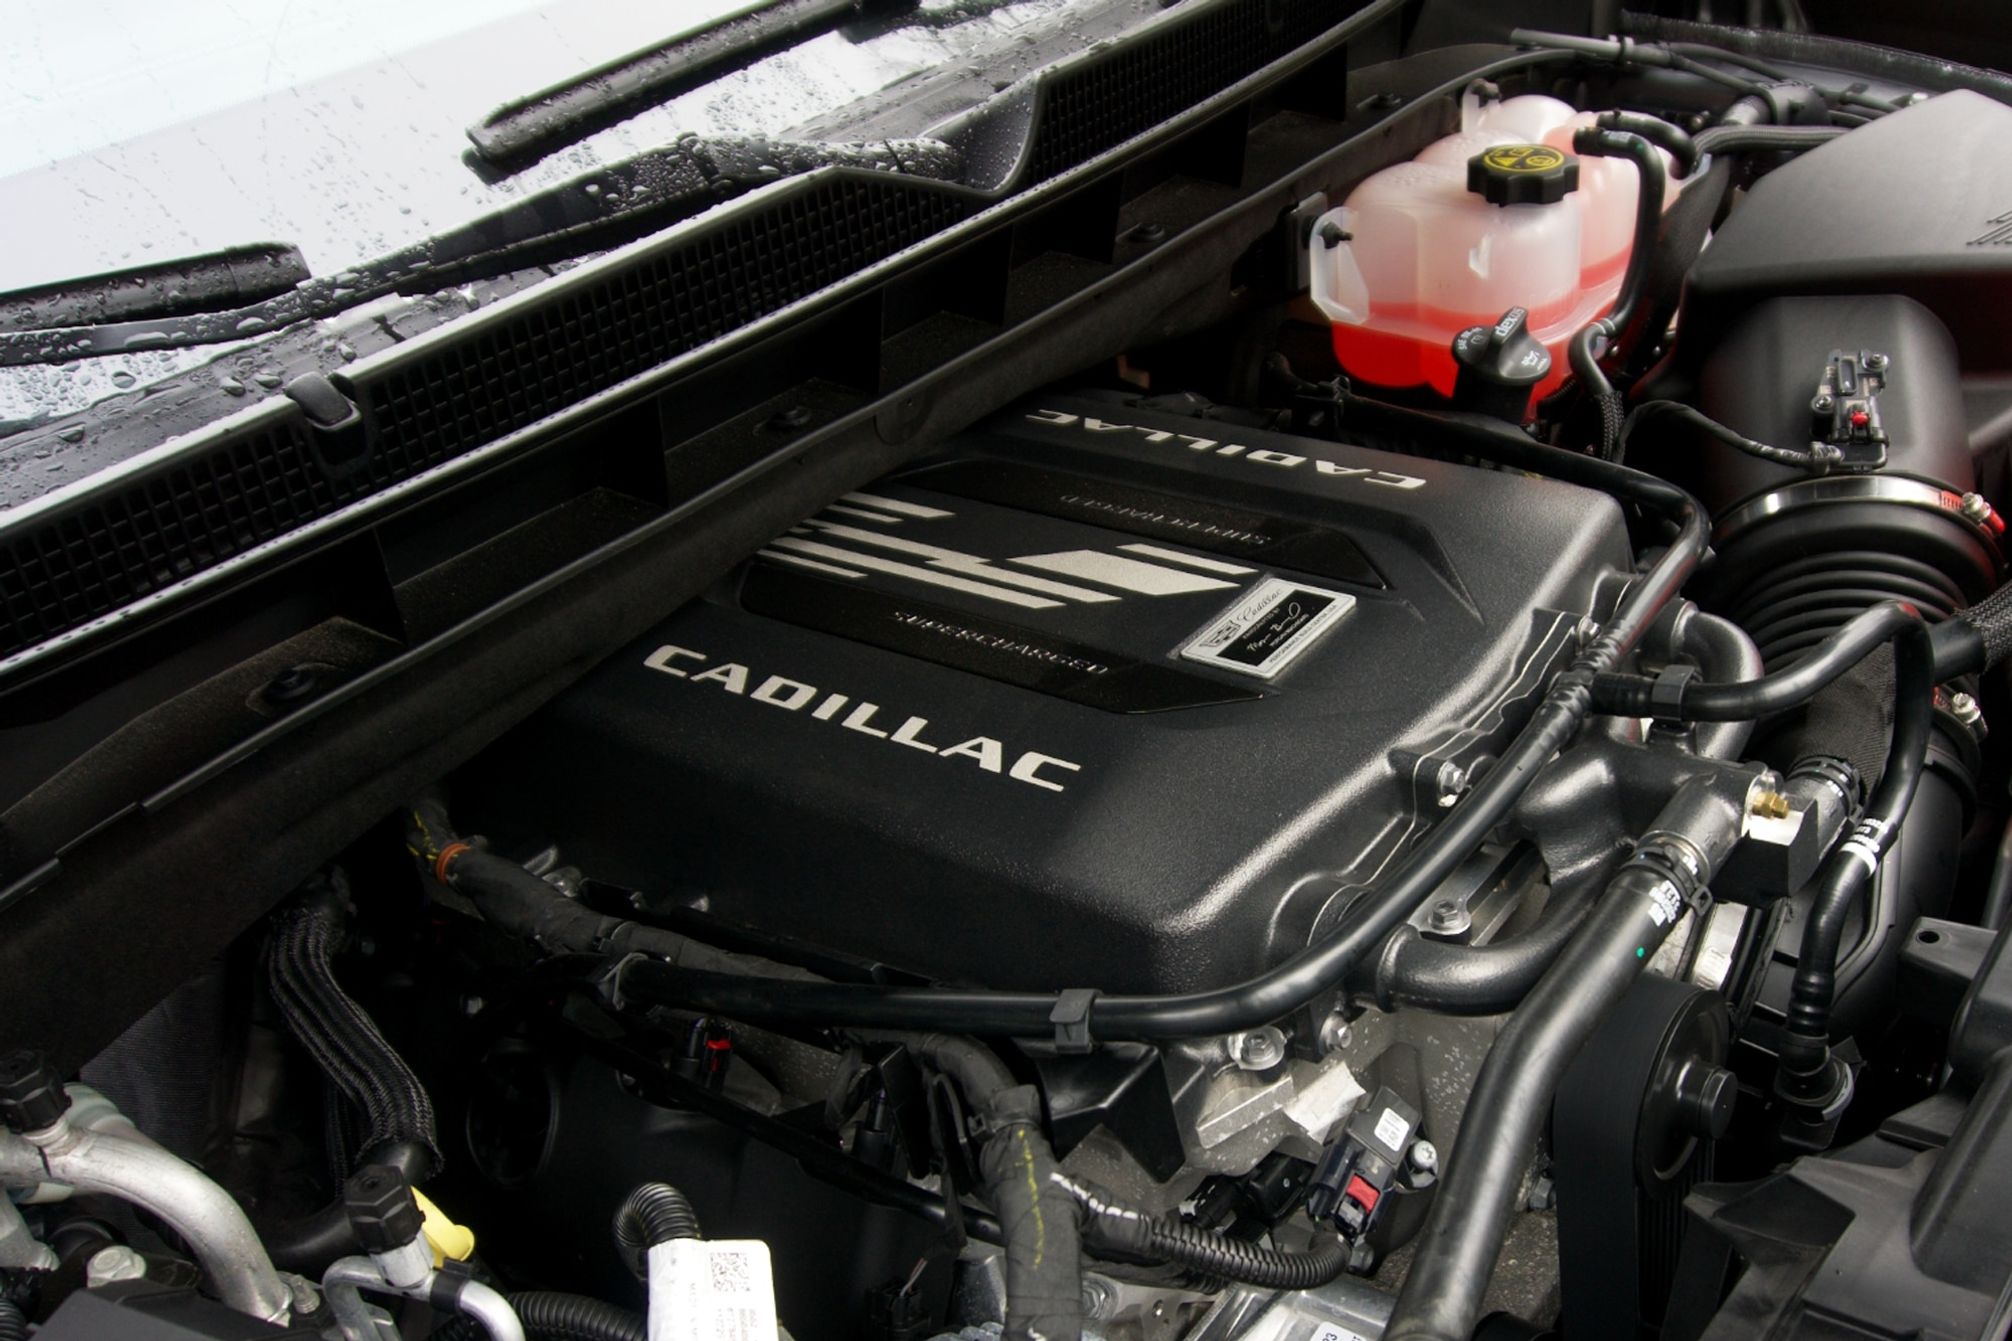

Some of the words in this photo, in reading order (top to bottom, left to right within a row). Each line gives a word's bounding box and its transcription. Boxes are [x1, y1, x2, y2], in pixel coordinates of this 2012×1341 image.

[1494, 307, 1525, 337] dexos
[1025, 409, 1427, 489] CADILLAC
[894, 611, 1109, 674] SUPERCHARGED
[642, 644, 1081, 792] CADILLAC
